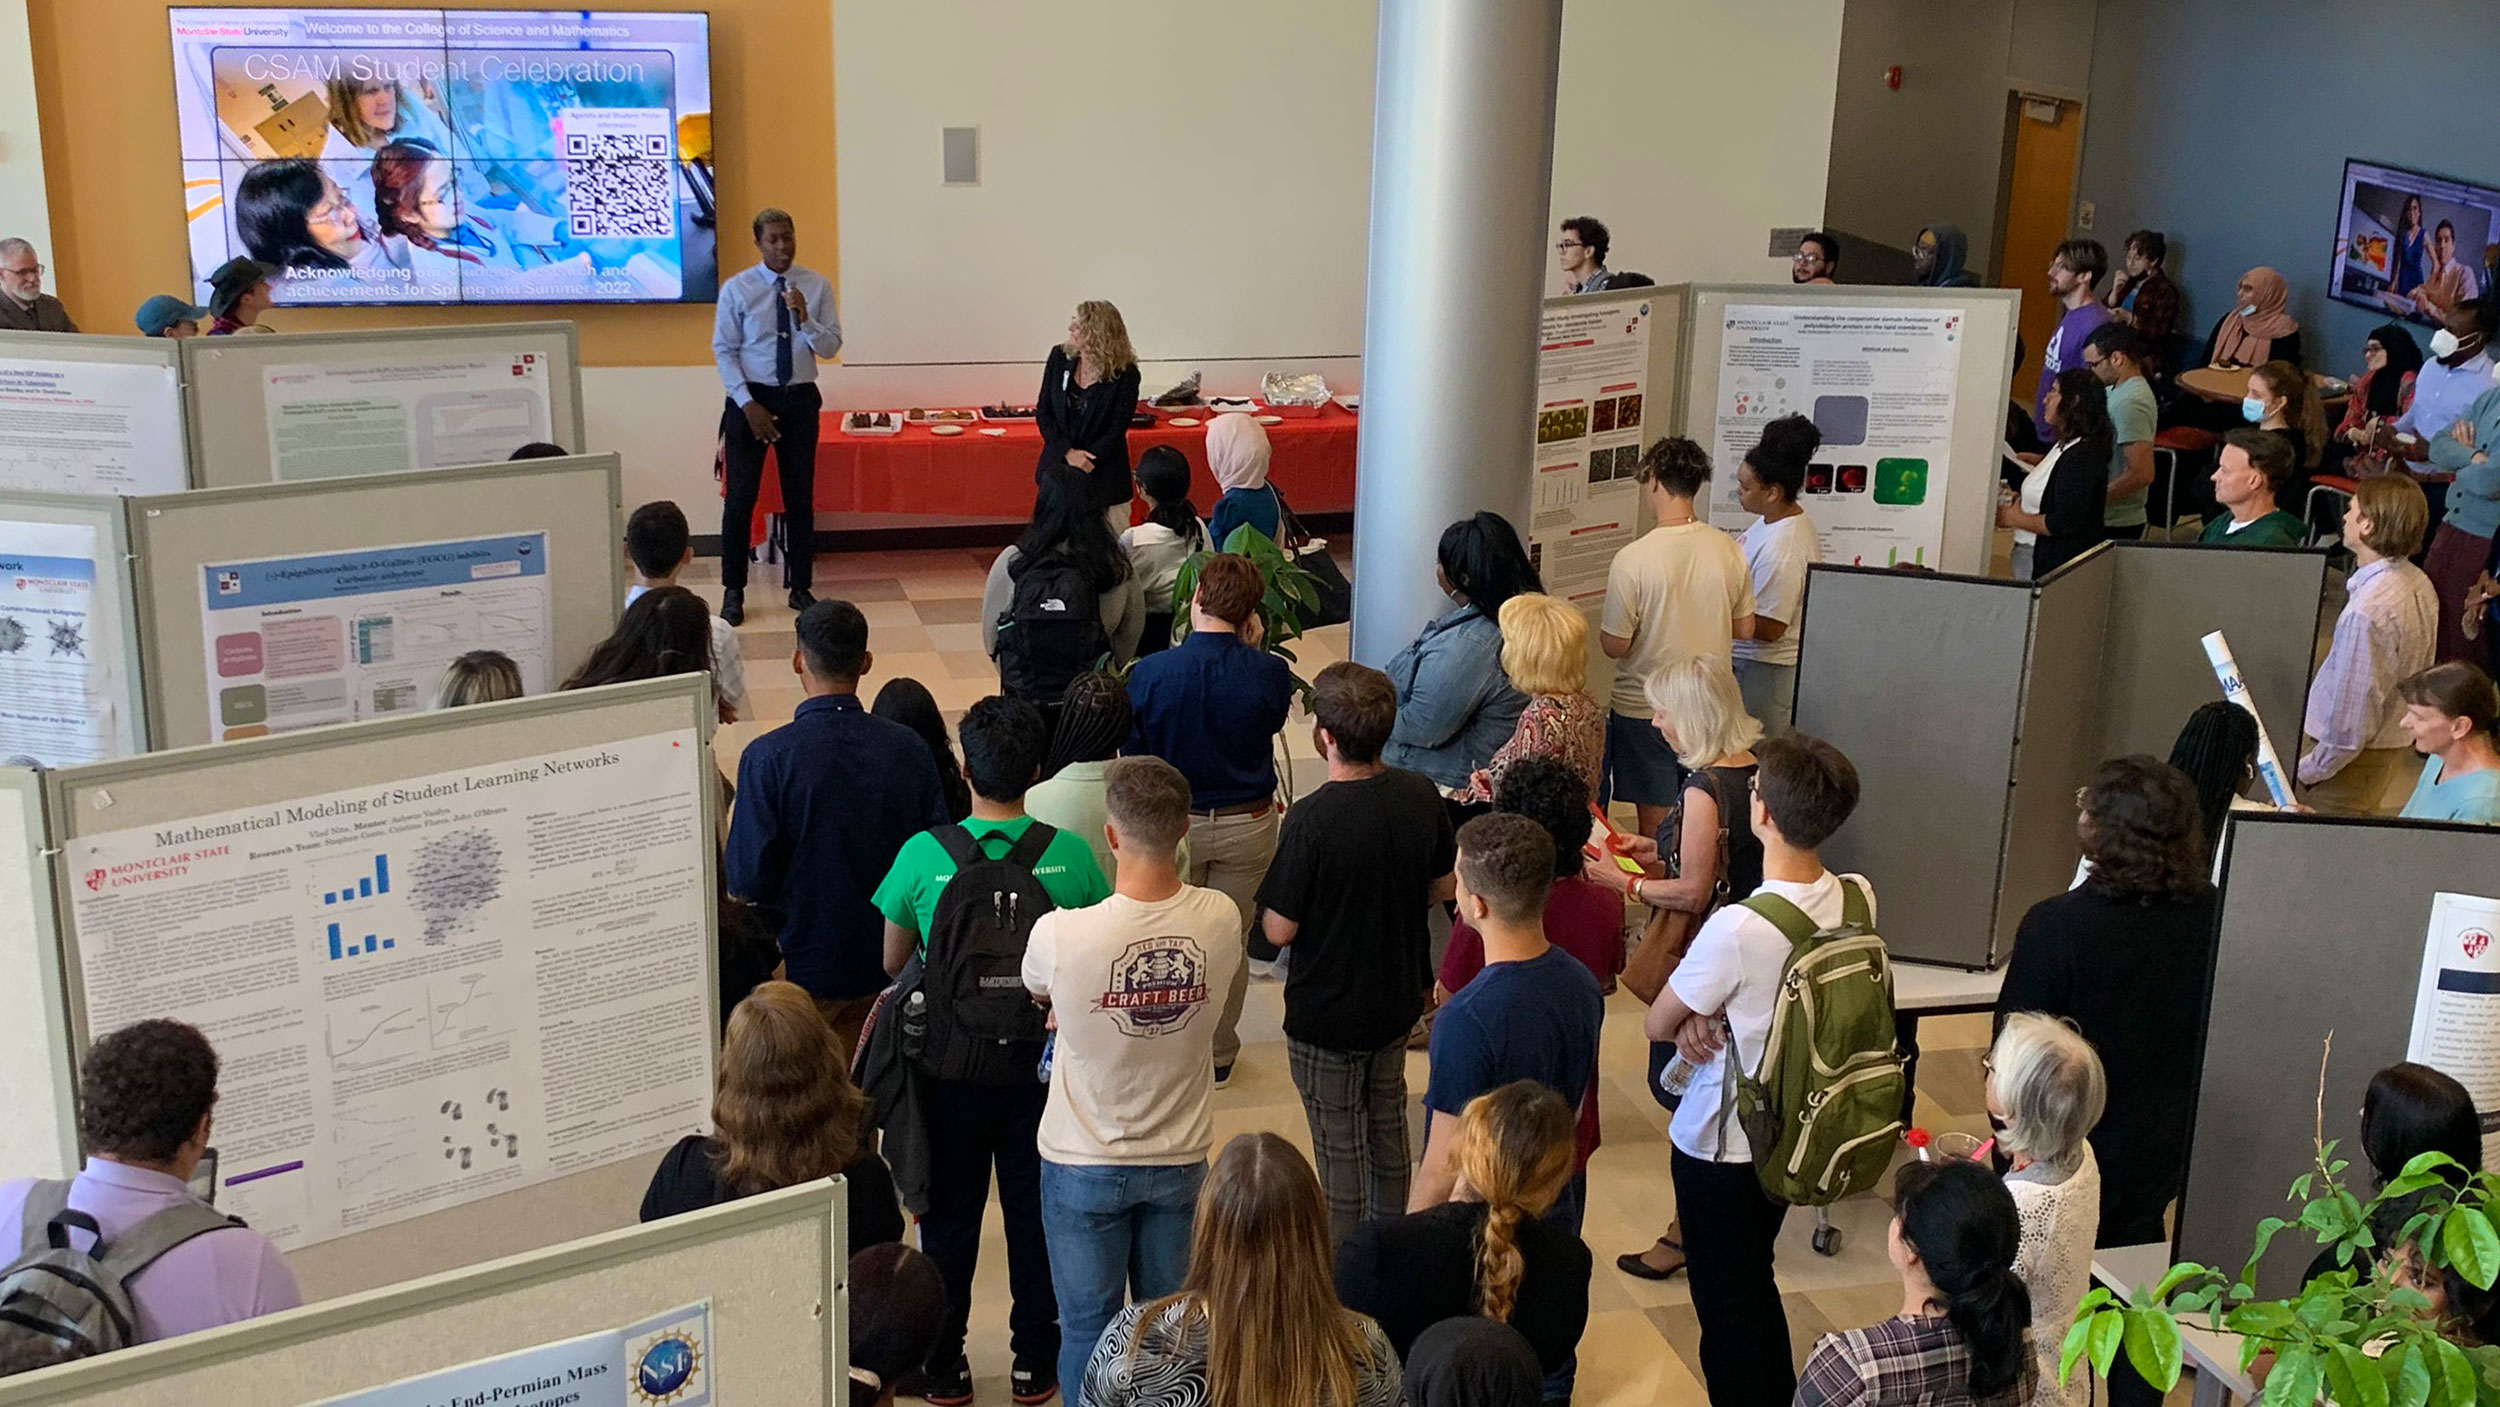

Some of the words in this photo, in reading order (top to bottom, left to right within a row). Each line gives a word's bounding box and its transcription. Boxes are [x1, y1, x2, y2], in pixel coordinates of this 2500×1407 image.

[244, 27, 288, 37] University
[306, 23, 363, 35] Welcome
[367, 24, 379, 35] to
[382, 23, 401, 35] the
[405, 23, 455, 38] College
[458, 25, 471, 36] of
[474, 25, 523, 37] Science
[527, 25, 549, 37] and
[553, 25, 630, 38] Mathematics
[245, 54, 341, 80] CSAM
[352, 54, 470, 82] Student
[480, 56, 644, 83] Celebration
[285, 266, 411, 281] Acknowledging
[286, 284, 400, 297] achievements
[404, 284, 424, 296] for
[431, 283, 486, 298] Spring
[491, 285, 520, 295] and
[525, 283, 590, 295] Summer
[595, 281, 632, 294] 2022
[156, 811, 281, 848] Mathematical
[287, 800, 368, 824] Modeling
[372, 792, 389, 808] of
[393, 782, 459, 804] Student
[465, 767, 539, 791] Learning
[544, 752, 620, 777] Networks
[110, 853, 190, 875] MONTCLAIR
[194, 845, 231, 861] STATE
[249, 845, 293, 860] Research
[111, 865, 190, 888] UNIVERSITY
[1169, 940, 1185, 948] TAP
[1142, 980, 1178, 989] PREMIUM
[1107, 990, 1161, 1006] CRAFT
[1168, 986, 1205, 1003] BEER
[641, 1352, 691, 1385] NSF
[451, 1375, 562, 1407] End-Permian
[567, 1364, 608, 1385] Mass
